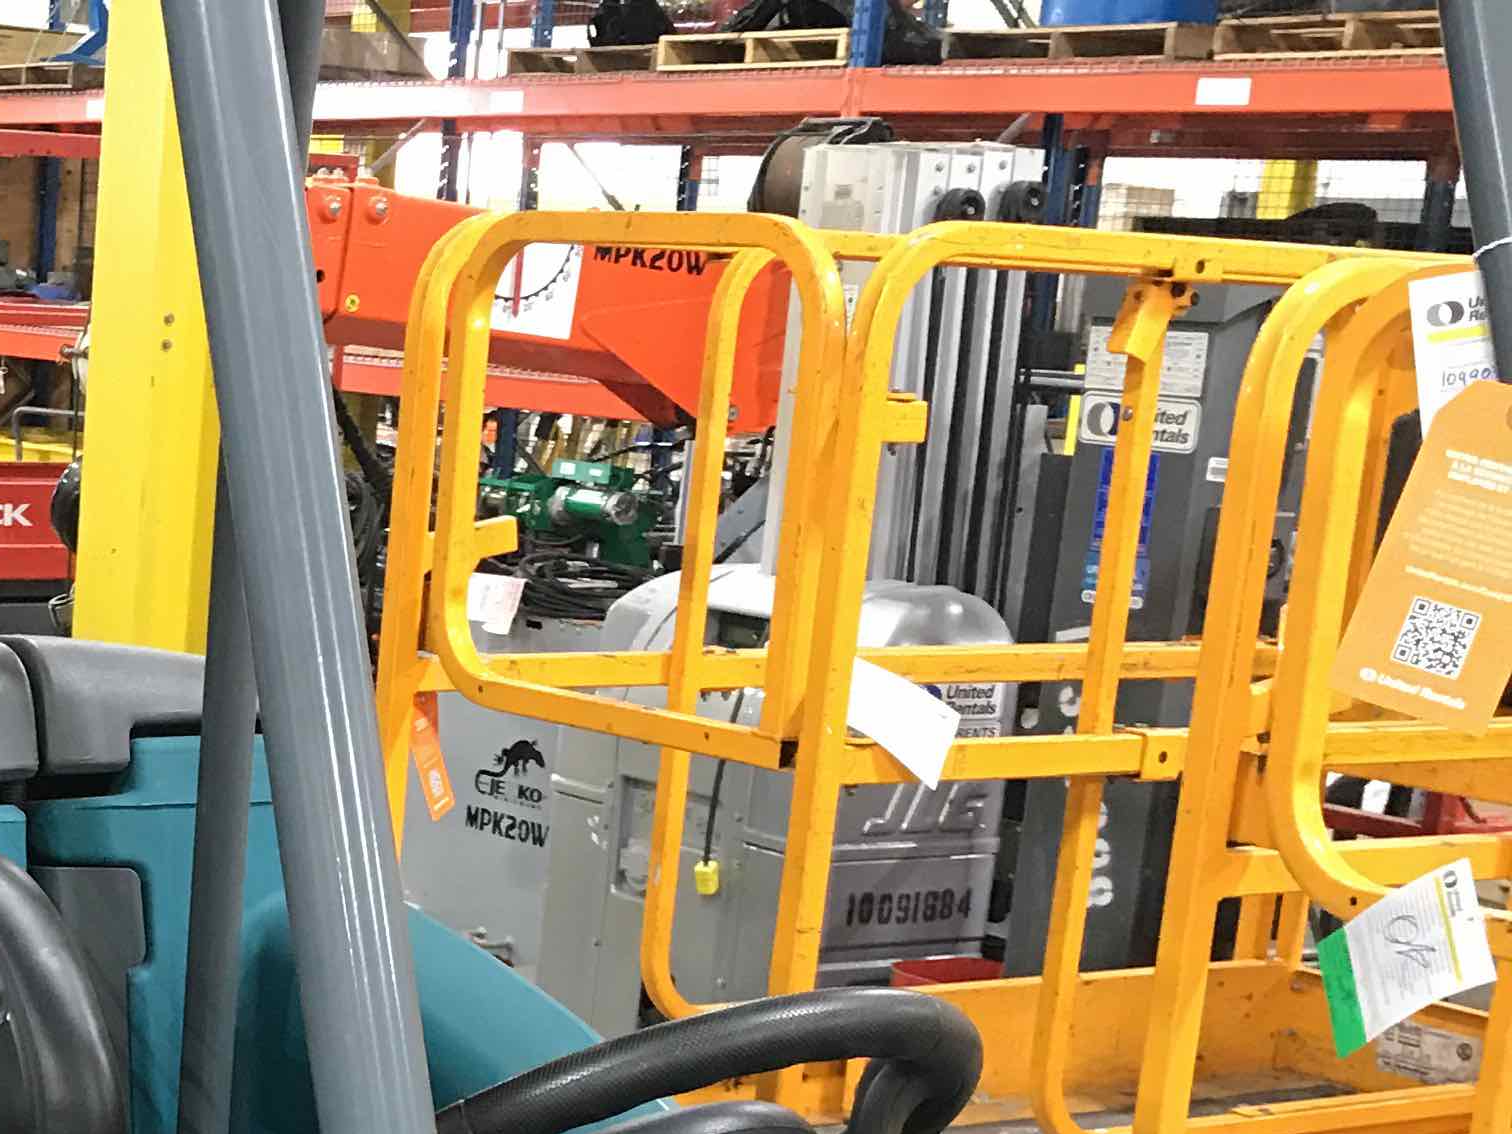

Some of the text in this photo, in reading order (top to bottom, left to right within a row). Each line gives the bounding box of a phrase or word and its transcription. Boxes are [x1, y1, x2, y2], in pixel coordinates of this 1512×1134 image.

[593, 245, 707, 275] MPK20W
[1154, 408, 1188, 426] ited
[1152, 429, 1190, 445] ntals
[946, 684, 994, 699] United
[465, 805, 550, 847] MPK20W
